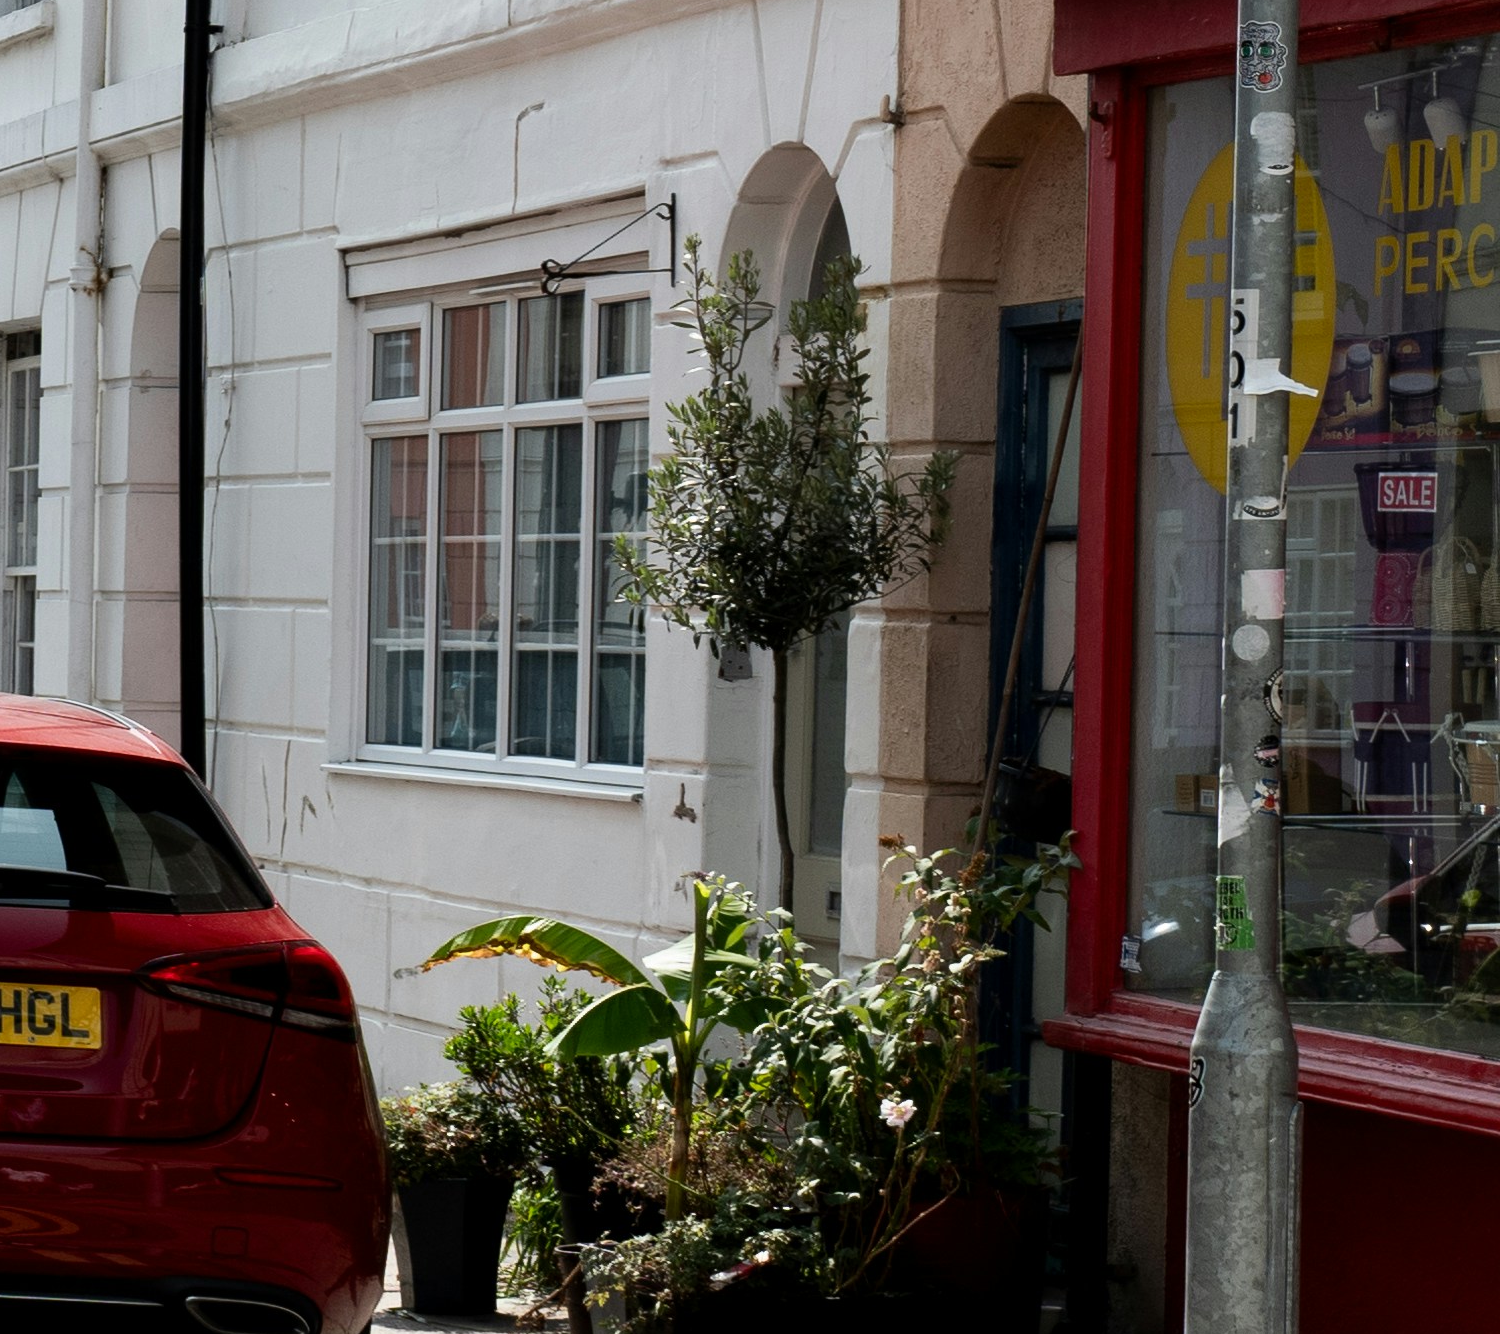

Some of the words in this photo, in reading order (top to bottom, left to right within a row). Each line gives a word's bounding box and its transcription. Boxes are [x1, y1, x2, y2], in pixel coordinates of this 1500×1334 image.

[1377, 130, 1498, 216] ADAP
[1373, 223, 1496, 299] PERC
[1384, 479, 1432, 506] SALE
